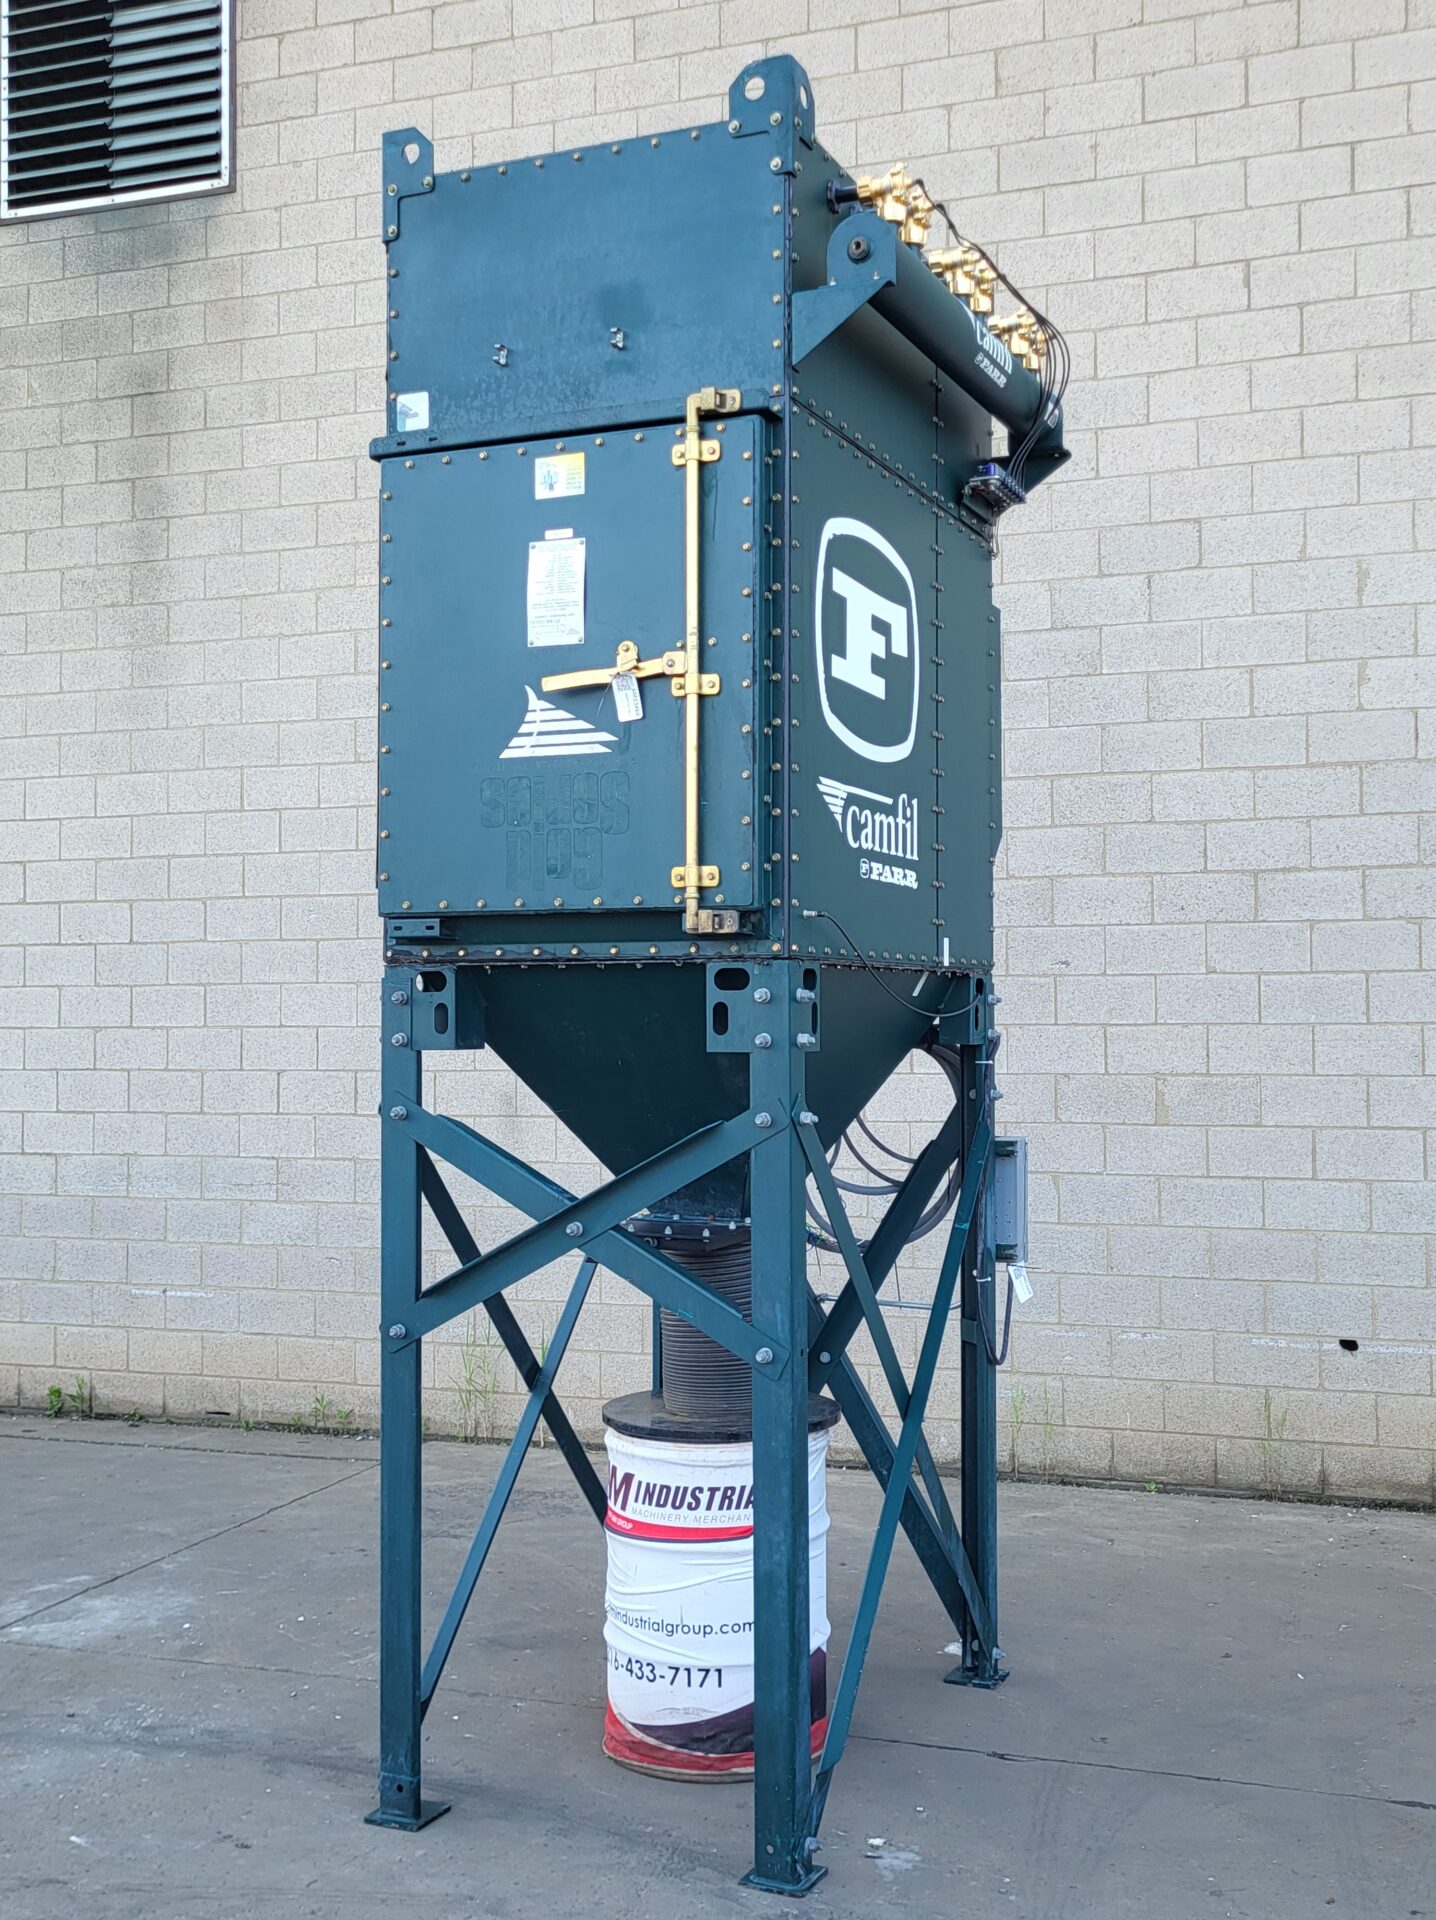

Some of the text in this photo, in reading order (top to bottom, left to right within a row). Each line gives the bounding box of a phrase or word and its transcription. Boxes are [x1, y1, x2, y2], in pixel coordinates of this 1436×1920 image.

[831, 566, 908, 700] F
[870, 861, 919, 889] FARR
[631, 1506, 688, 1523] MACHINERY
